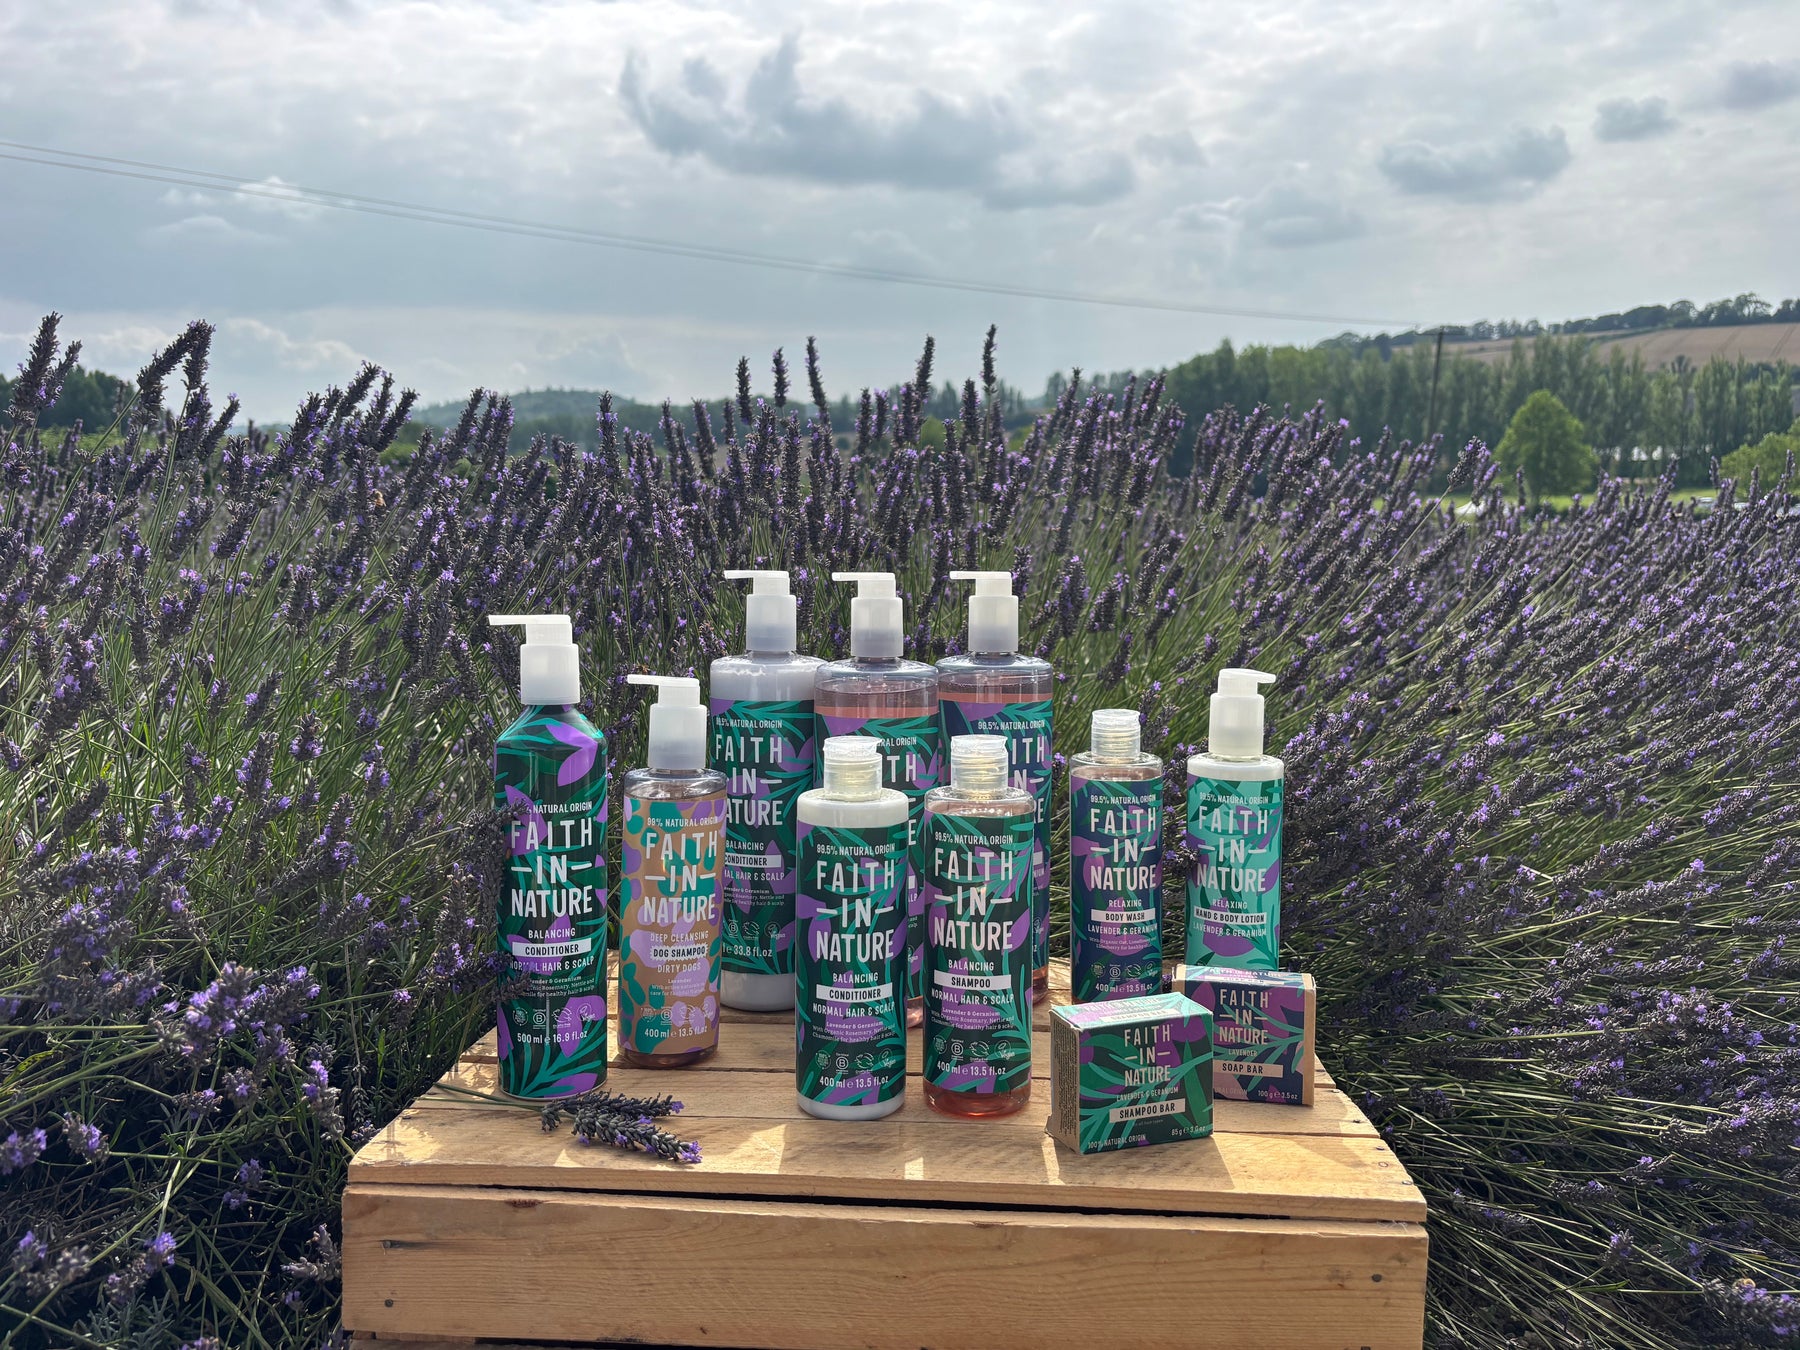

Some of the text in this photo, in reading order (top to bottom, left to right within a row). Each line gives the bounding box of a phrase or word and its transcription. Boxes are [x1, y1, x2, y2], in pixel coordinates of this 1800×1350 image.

[730, 719, 758, 728] NATURAL
[760, 720, 782, 728] ORIGIN
[978, 721, 1045, 730] 99.5% NATURAL ORIGIN
[896, 737, 917, 746] ORIGIN
[716, 734, 782, 763] FAITH
[1012, 736, 1045, 764] ITH
[1090, 795, 1109, 804] 99.5%
[1140, 794, 1156, 803] ORIGIN
[1218, 796, 1248, 805] NATURAL
[533, 801, 593, 814] NATURAL ORIGIN
[726, 799, 783, 825] ATURE
[647, 816, 718, 827] 99% NATURAL ORIGIN
[1090, 807, 1156, 834] FAITH
[1199, 806, 1268, 835] FAITH
[511, 817, 592, 850] FAITH
[935, 832, 1013, 845] 99.5% NATURAL ORIGIN
[646, 831, 717, 860] FAITH
[726, 840, 764, 851] BALANCING
[817, 843, 895, 856] 99.5% NATURAL ORIGIN
[725, 855, 767, 866] CONDITIONER
[935, 848, 1013, 881] FAITH
[736, 870, 752, 880] HAIR
[761, 872, 785, 881] SCALP
[817, 859, 894, 892] FAITH
[1090, 864, 1156, 891] NATURE
[1197, 863, 1266, 893] NATURE
[511, 885, 593, 918] NATURE
[1109, 900, 1142, 908] RELAXING
[1213, 899, 1247, 909] RELAXING
[644, 894, 716, 923] NATURE
[1105, 912, 1145, 921] BODY WASH
[1196, 908, 1211, 919] HAND
[1220, 914, 1239, 923] BODY
[1241, 915, 1265, 923] LOTION
[528, 928, 576, 939] BALANCING
[934, 917, 1013, 951] NATURE
[1087, 924, 1120, 935] LAVENDER
[1193, 922, 1224, 936] LAVENDER
[1233, 928, 1266, 938] GERANIUM
[651, 931, 709, 942] DEEP CLEANSING
[525, 944, 579, 955] CONDITIONER
[734, 945, 751, 955] 33.8
[817, 929, 894, 962] NATURE
[653, 946, 706, 958] DOG SHAMPOO
[542, 962, 562, 972] HAIR
[572, 956, 594, 969] SCALP
[657, 963, 701, 973] DIRTY DOGS
[948, 960, 995, 971] BALANCING
[832, 973, 879, 983] BALANCING
[951, 977, 991, 988] SHAMPOO
[829, 989, 881, 1000] CONDITIONER
[1096, 984, 1109, 992] 400
[1110, 985, 1118, 993] ml
[1126, 985, 1139, 993] 13.5
[931, 988, 959, 1003] NORMAL
[960, 996, 980, 1005] HAIR
[990, 995, 1014, 1004] SCALP
[1220, 989, 1269, 1008] FAITH
[813, 1003, 844, 1017] NORMAL
[846, 1008, 865, 1017] HAIR
[875, 1002, 895, 1015] SCALP
[943, 1008, 966, 1016] Lavender
[857, 1021, 883, 1029] Geranium
[517, 1033, 532, 1043] 500
[533, 1035, 542, 1044] ml
[553, 1033, 570, 1043] 16.9
[644, 1028, 693, 1038] 400 ml 13.5
[1124, 1025, 1170, 1047] FAITH
[1220, 1027, 1268, 1045] NATURE
[1228, 1049, 1257, 1057] LAVENDER
[937, 1061, 950, 1072] 400
[951, 1064, 960, 1074] ml
[970, 1065, 987, 1076] 13.5
[1222, 1063, 1263, 1074] SOAP BAR
[820, 1076, 834, 1087] 400
[836, 1078, 845, 1088] ml
[855, 1077, 872, 1088] 13.5
[1124, 1065, 1171, 1087] NATURE
[1117, 1091, 1145, 1102] LAVENDER
[1151, 1087, 1179, 1098] GERANIUM
[1120, 1103, 1175, 1119] SHAMPOO BAR
[1104, 1138, 1127, 1146] NATURAL
[1128, 1134, 1146, 1143] ORIGIN
